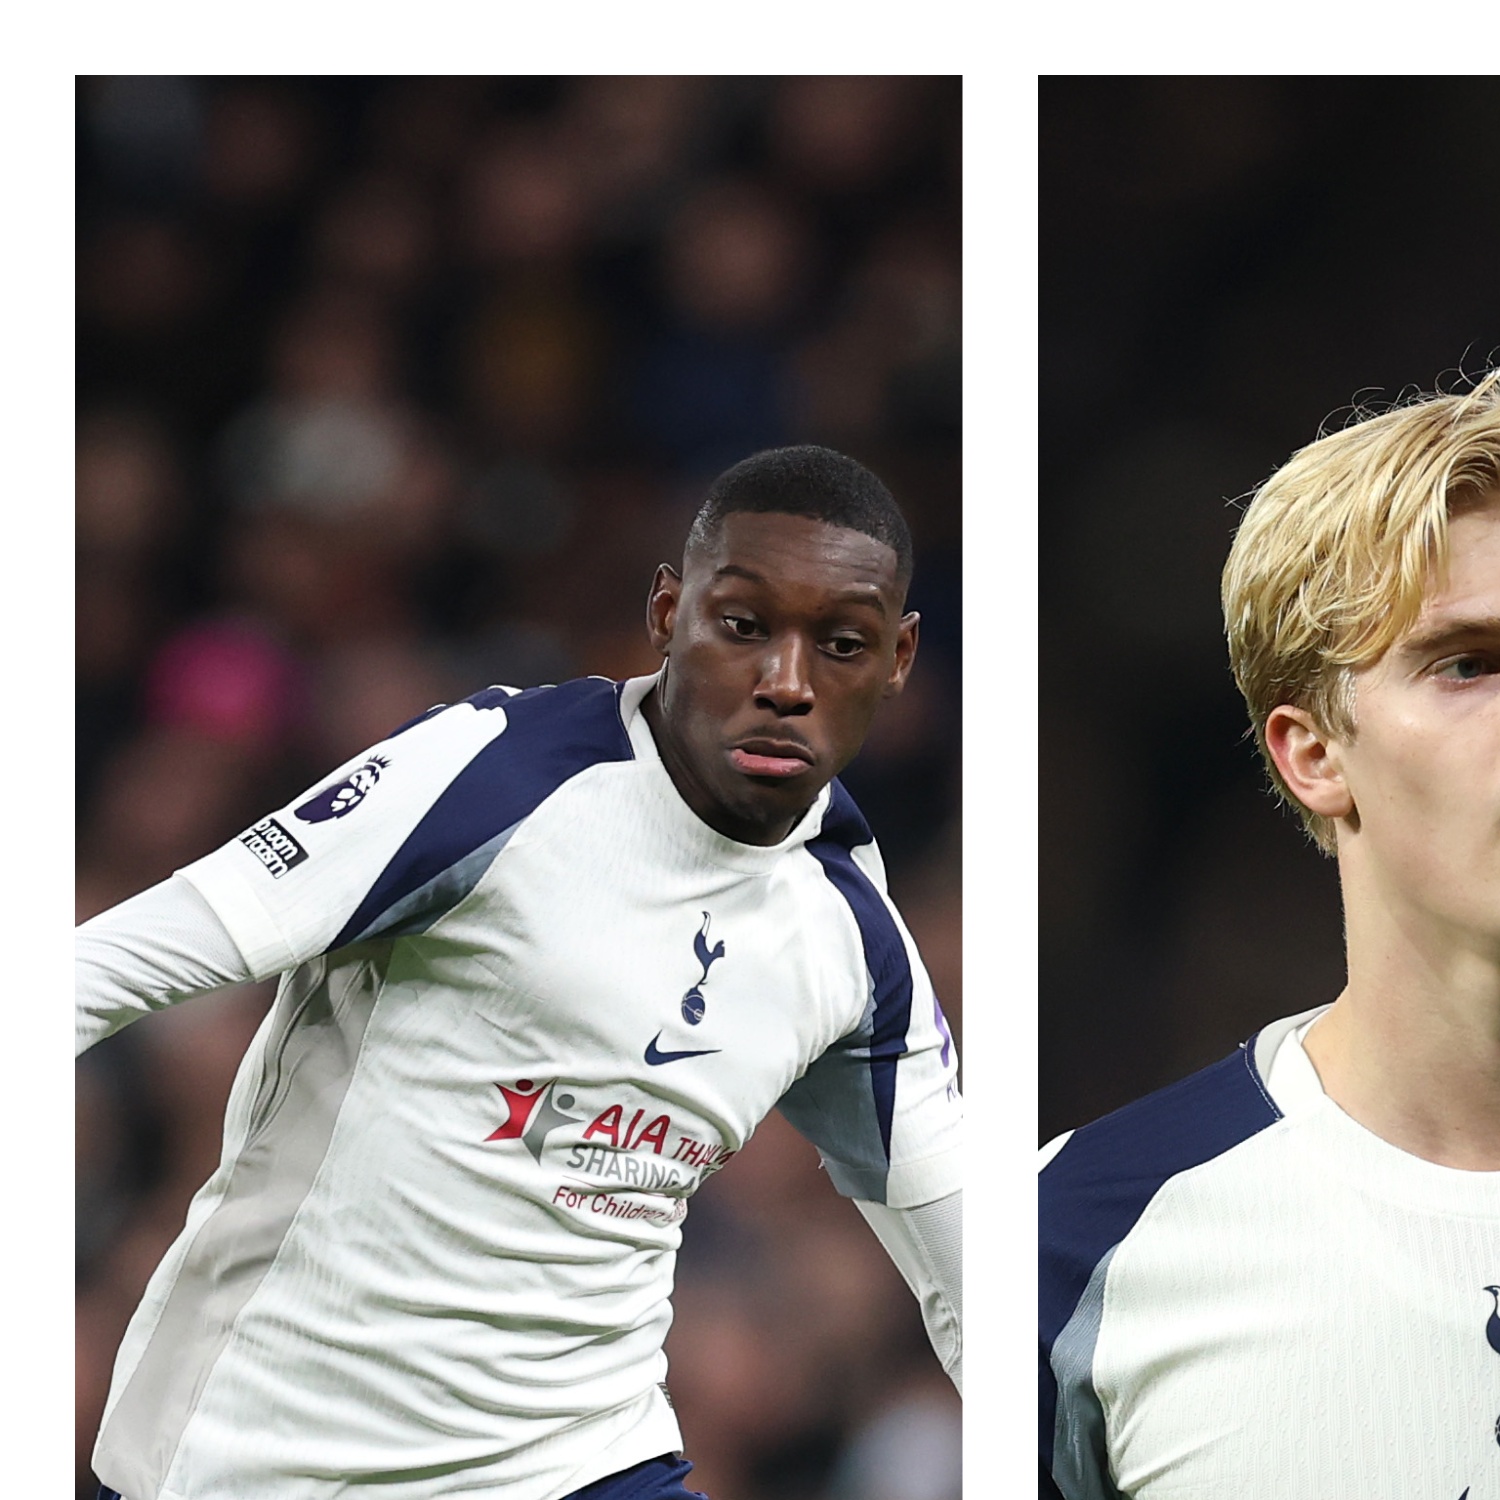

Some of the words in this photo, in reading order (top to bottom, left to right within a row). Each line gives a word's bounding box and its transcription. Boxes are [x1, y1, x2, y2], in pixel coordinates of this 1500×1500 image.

[260, 825, 299, 861] room
[582, 1104, 671, 1154] AIA
[552, 1186, 587, 1208] For
